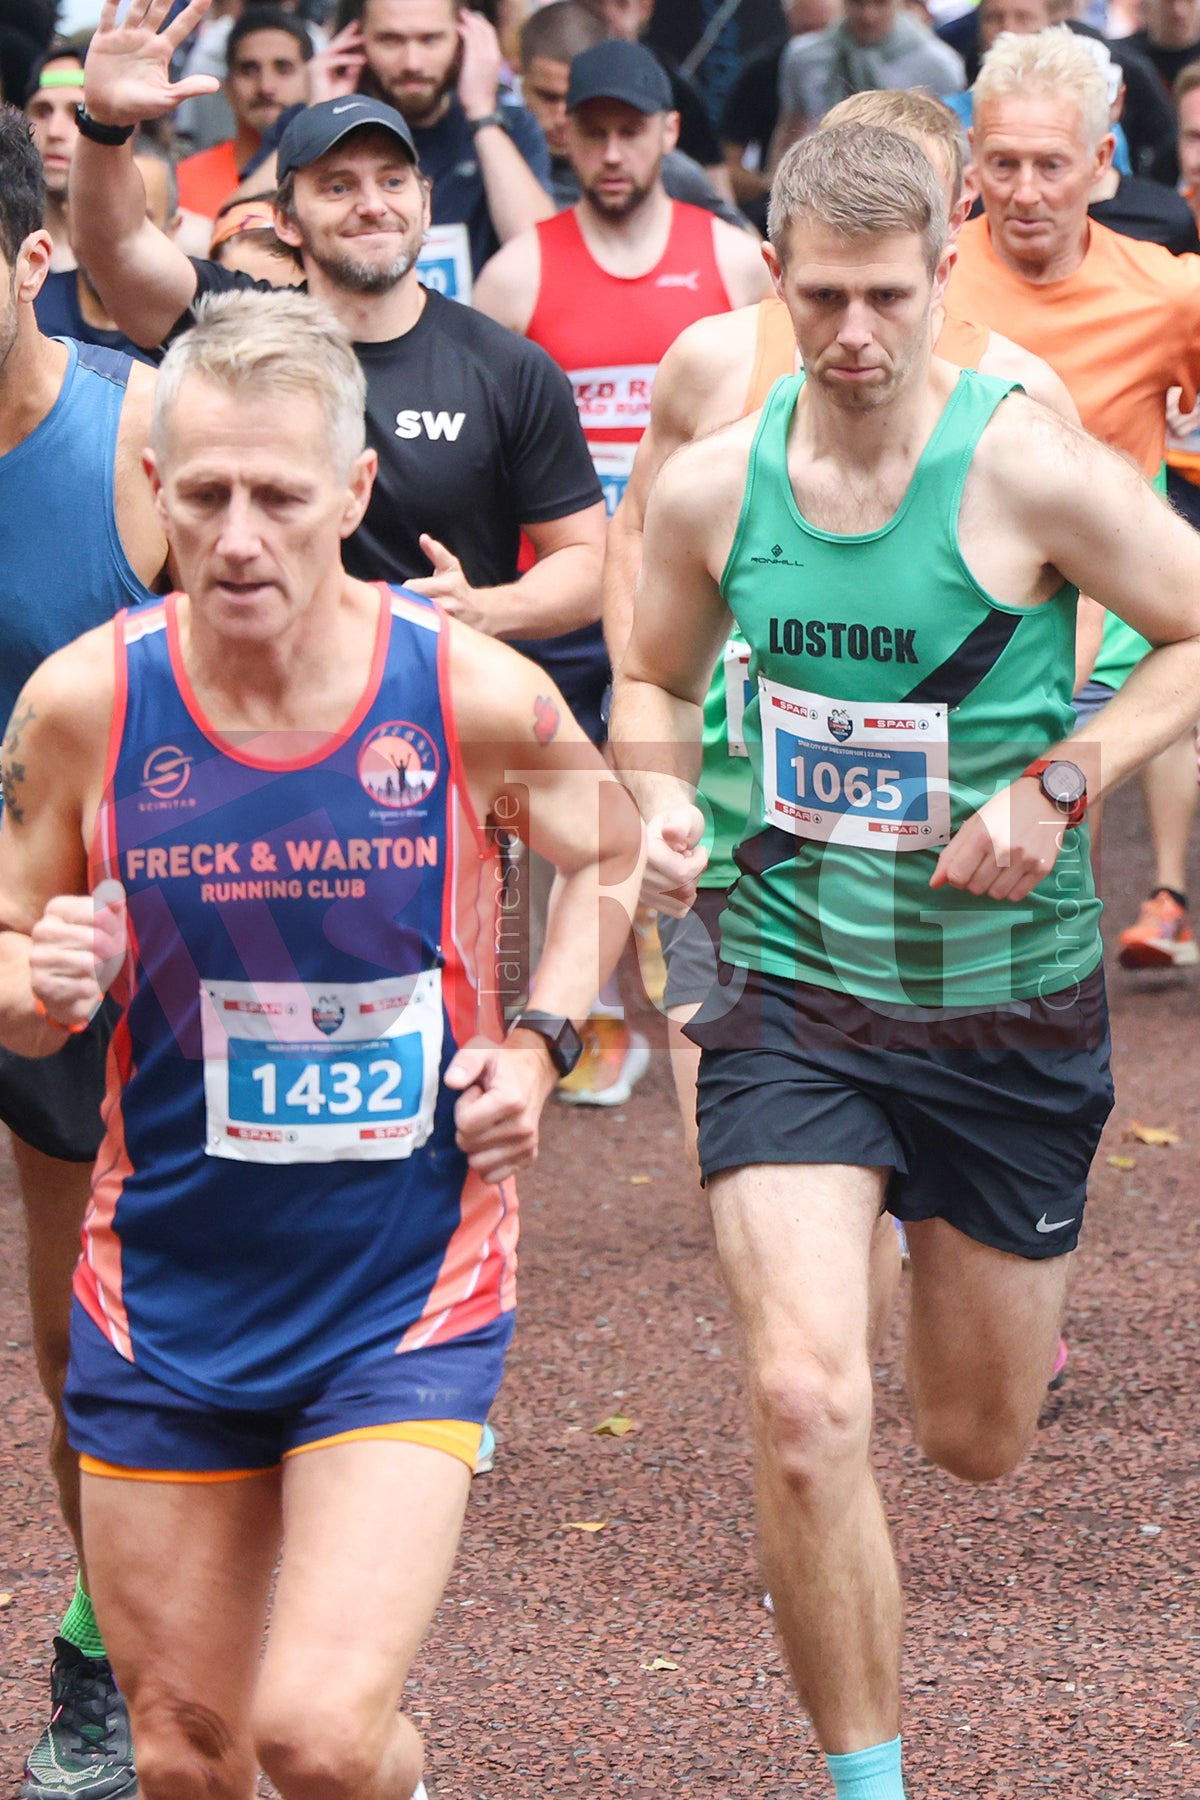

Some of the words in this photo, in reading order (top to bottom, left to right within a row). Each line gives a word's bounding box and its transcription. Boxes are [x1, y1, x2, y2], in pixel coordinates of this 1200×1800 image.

[394, 410, 466, 441] SW
[751, 557, 804, 567] RONHILL
[769, 617, 919, 665] LOSTOCK
[779, 700, 808, 718] SPAR
[876, 718, 916, 730] SPAR
[790, 755, 903, 812] 1065
[782, 804, 811, 821] SPAR
[880, 823, 919, 835] SPAR
[125, 841, 241, 880] FRECK
[250, 840, 279, 873] &
[285, 835, 438, 873] WARTON
[200, 879, 303, 903] RUNNING
[307, 878, 366, 899] CLUB
[251, 1058, 403, 1116] 1432
[238, 1127, 283, 1142] SPAR
